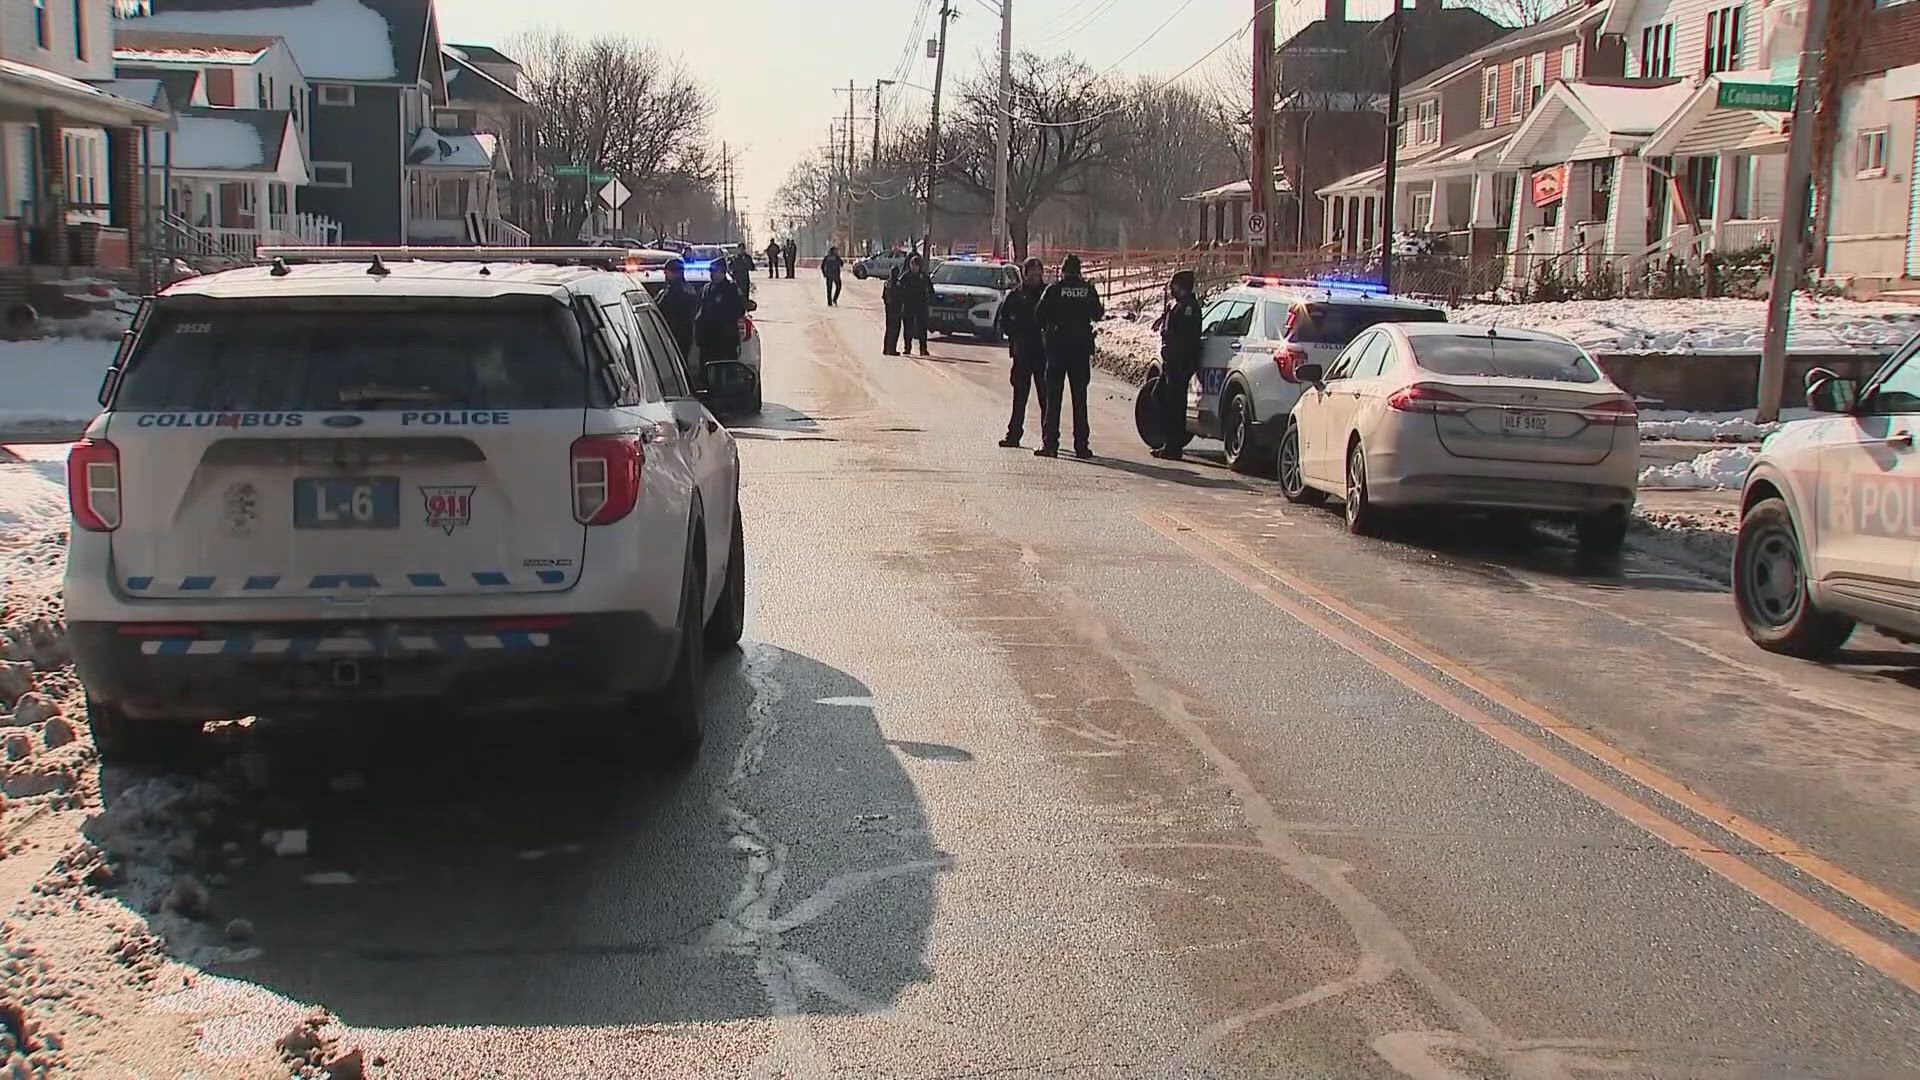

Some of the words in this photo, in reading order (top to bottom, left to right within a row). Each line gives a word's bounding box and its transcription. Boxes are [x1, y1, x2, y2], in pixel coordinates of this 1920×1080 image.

[1728, 89, 1780, 105] Columbus
[400, 411, 511, 426] POLICE
[315, 486, 374, 521] L-6
[429, 495, 467, 518] 911
